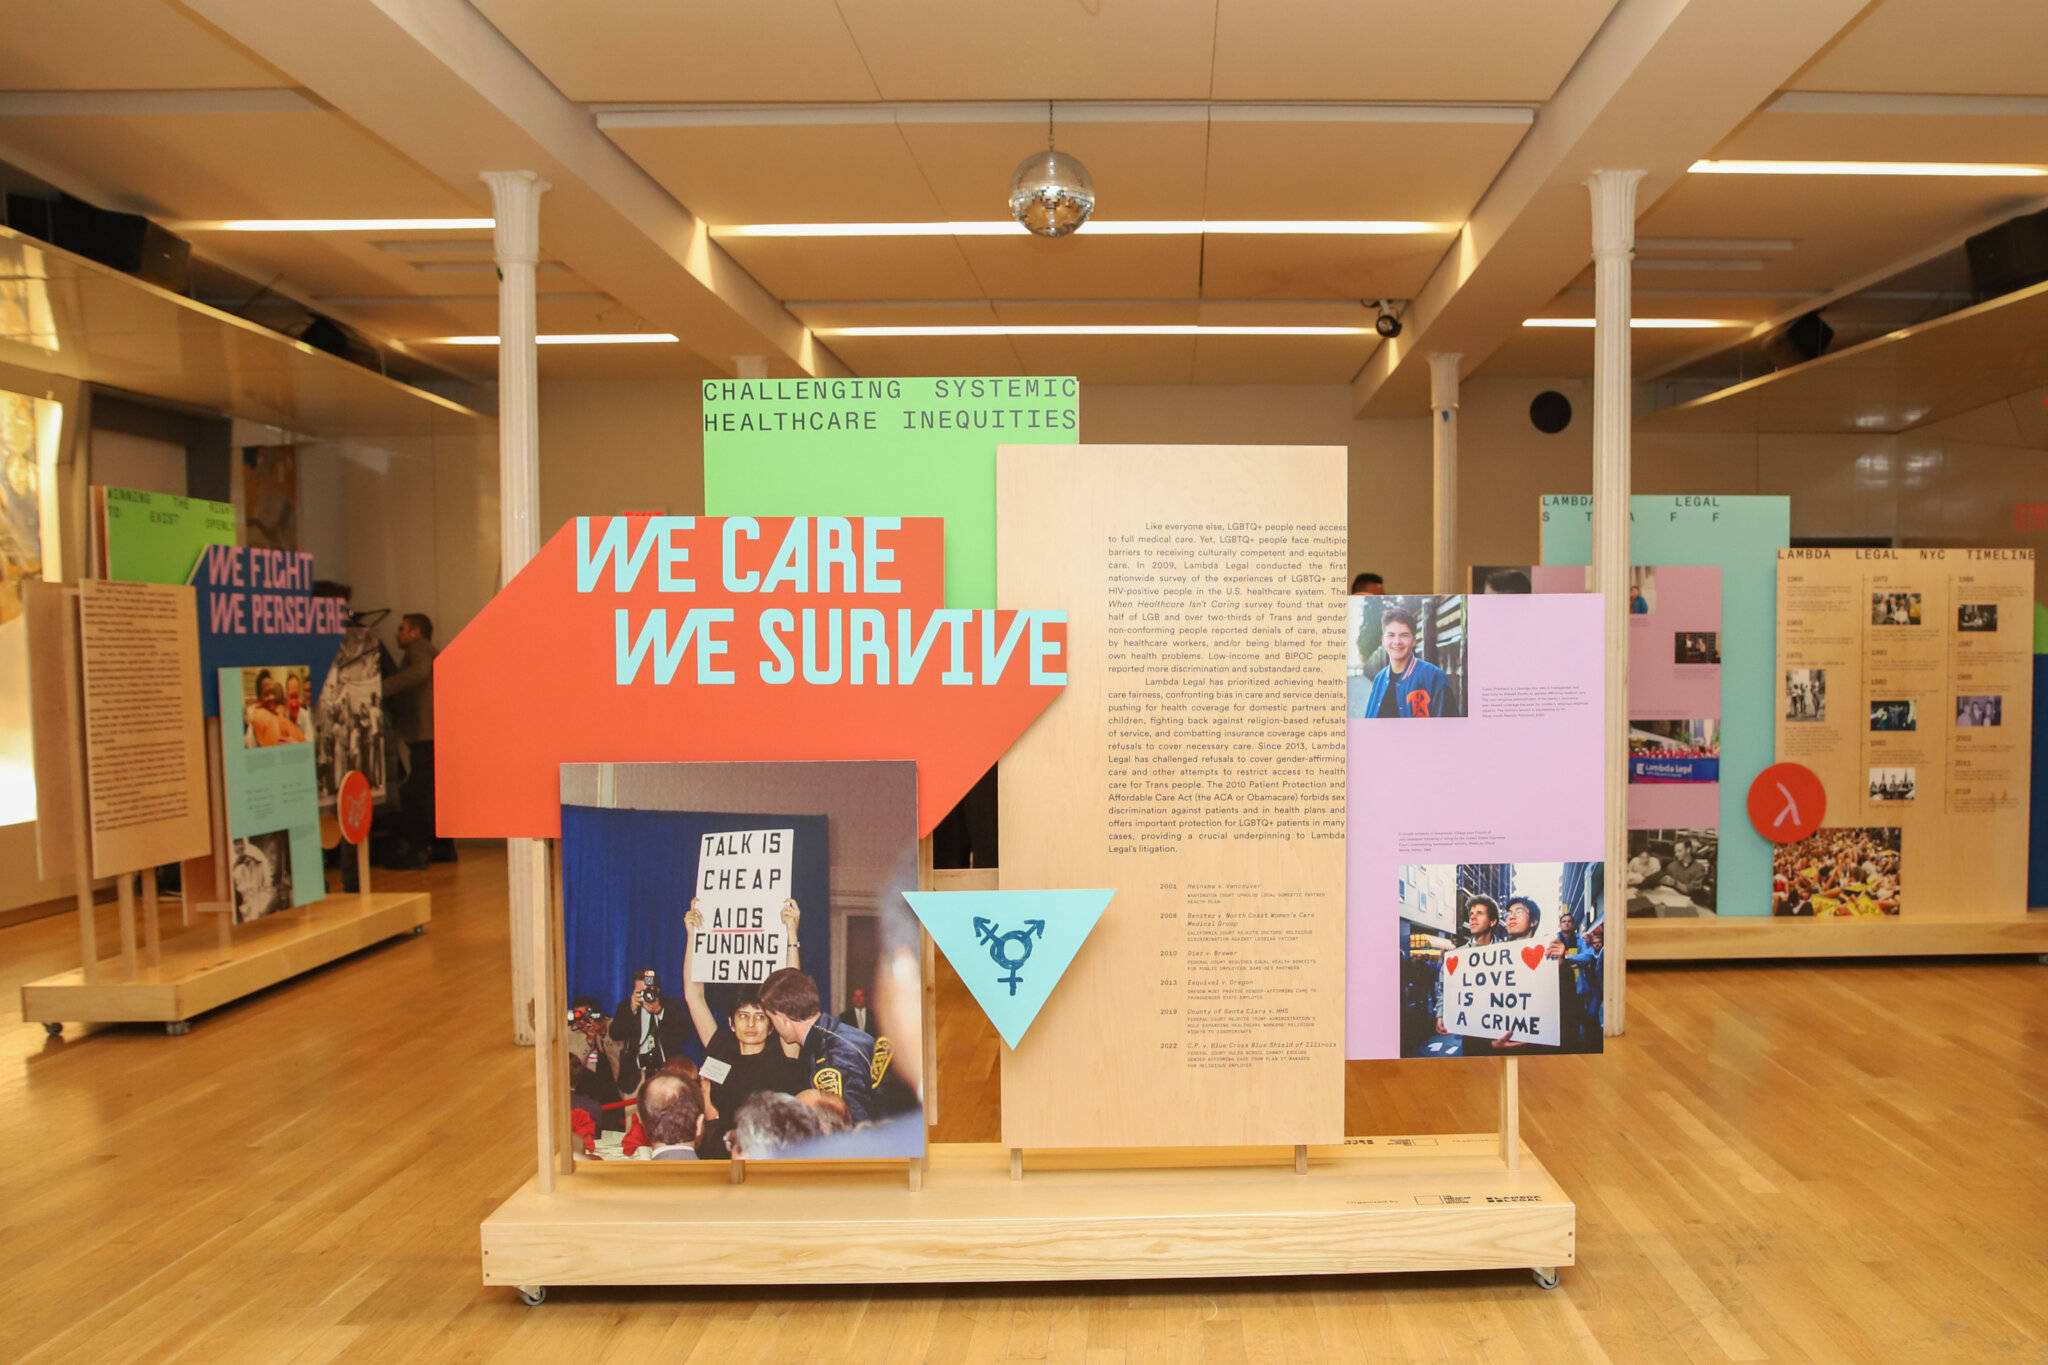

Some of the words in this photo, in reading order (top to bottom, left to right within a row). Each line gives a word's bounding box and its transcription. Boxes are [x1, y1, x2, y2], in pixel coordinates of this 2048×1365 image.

[703, 381, 901, 402] CHALLENGING
[934, 379, 1077, 398] SYSTEMIC
[704, 410, 878, 432] HEALTHCARE
[902, 409, 1077, 430] INEQUITIES
[1542, 496, 1594, 507] LAMBDA
[1676, 496, 1720, 507] LEGAL
[1145, 522, 1163, 530] Like
[1165, 524, 1204, 532] everyone
[1265, 523, 1294, 532] people
[1296, 523, 1317, 531] need
[1121, 535, 1135, 543] full
[1138, 535, 1171, 543] medical
[1258, 536, 1288, 545] people
[1291, 536, 1310, 544] face
[1313, 536, 1346, 545] multiple
[576, 516, 696, 593] WE
[722, 516, 902, 594] CARE
[1108, 548, 1141, 556] barriers
[1156, 548, 1195, 558] receiving
[1198, 548, 1237, 558] culturally
[1240, 550, 1286, 558] competent
[1289, 549, 1305, 557] and
[1308, 549, 1346, 558] equitable
[1777, 549, 1832, 560] LAMBDA
[1856, 549, 1899, 560] LEGAL
[1920, 549, 1946, 560] NYC
[1967, 549, 2035, 561] TIMELINE
[208, 545, 244, 586] WE
[249, 548, 313, 591] FIGHT
[1184, 561, 1219, 569] Lambda
[1225, 562, 1249, 571] Legal
[1308, 562, 1323, 570] the
[1329, 562, 1346, 570] first
[1108, 574, 1155, 582] nationwide
[1159, 576, 1187, 584] survey
[1191, 574, 1201, 582] of
[1204, 574, 1219, 582] the
[1223, 575, 1274, 584] experiences
[1277, 574, 1287, 582] of
[1330, 575, 1346, 583] and
[1108, 587, 1160, 596] HIV-positive
[1163, 587, 1193, 596] people
[1196, 587, 1204, 595] in
[1208, 587, 1223, 595] the
[1247, 587, 1292, 595] healthcare
[1330, 588, 1346, 596] The
[210, 592, 246, 634] WE
[252, 594, 347, 635] PERSEVERE
[616, 608, 735, 685] WE
[759, 608, 1067, 685] SURVIVE
[1108, 819, 1133, 827] offers
[1135, 819, 1176, 828] important
[1179, 819, 1222, 828] protection
[1224, 819, 1237, 827] for
[1276, 819, 1310, 828] patients
[1323, 820, 1345, 828] many
[705, 833, 752, 857] TALK
[763, 833, 781, 854] IS
[1141, 832, 1182, 841] providing
[1198, 831, 1228, 840] crucial
[1233, 832, 1291, 841] underpinning
[1311, 831, 1346, 839] Lambda
[704, 869, 781, 890] CHEAP
[713, 907, 763, 928] AIDS
[695, 933, 779, 955] FUNDING
[1469, 949, 1513, 968] OUR
[712, 960, 729, 981] IS
[738, 960, 777, 981] NOT
[1463, 970, 1516, 987] LOVE
[1458, 992, 1473, 1007] IS
[1490, 992, 1532, 1010] NOT
[1456, 1011, 1467, 1027] A
[1481, 1014, 1540, 1035] CRIME
